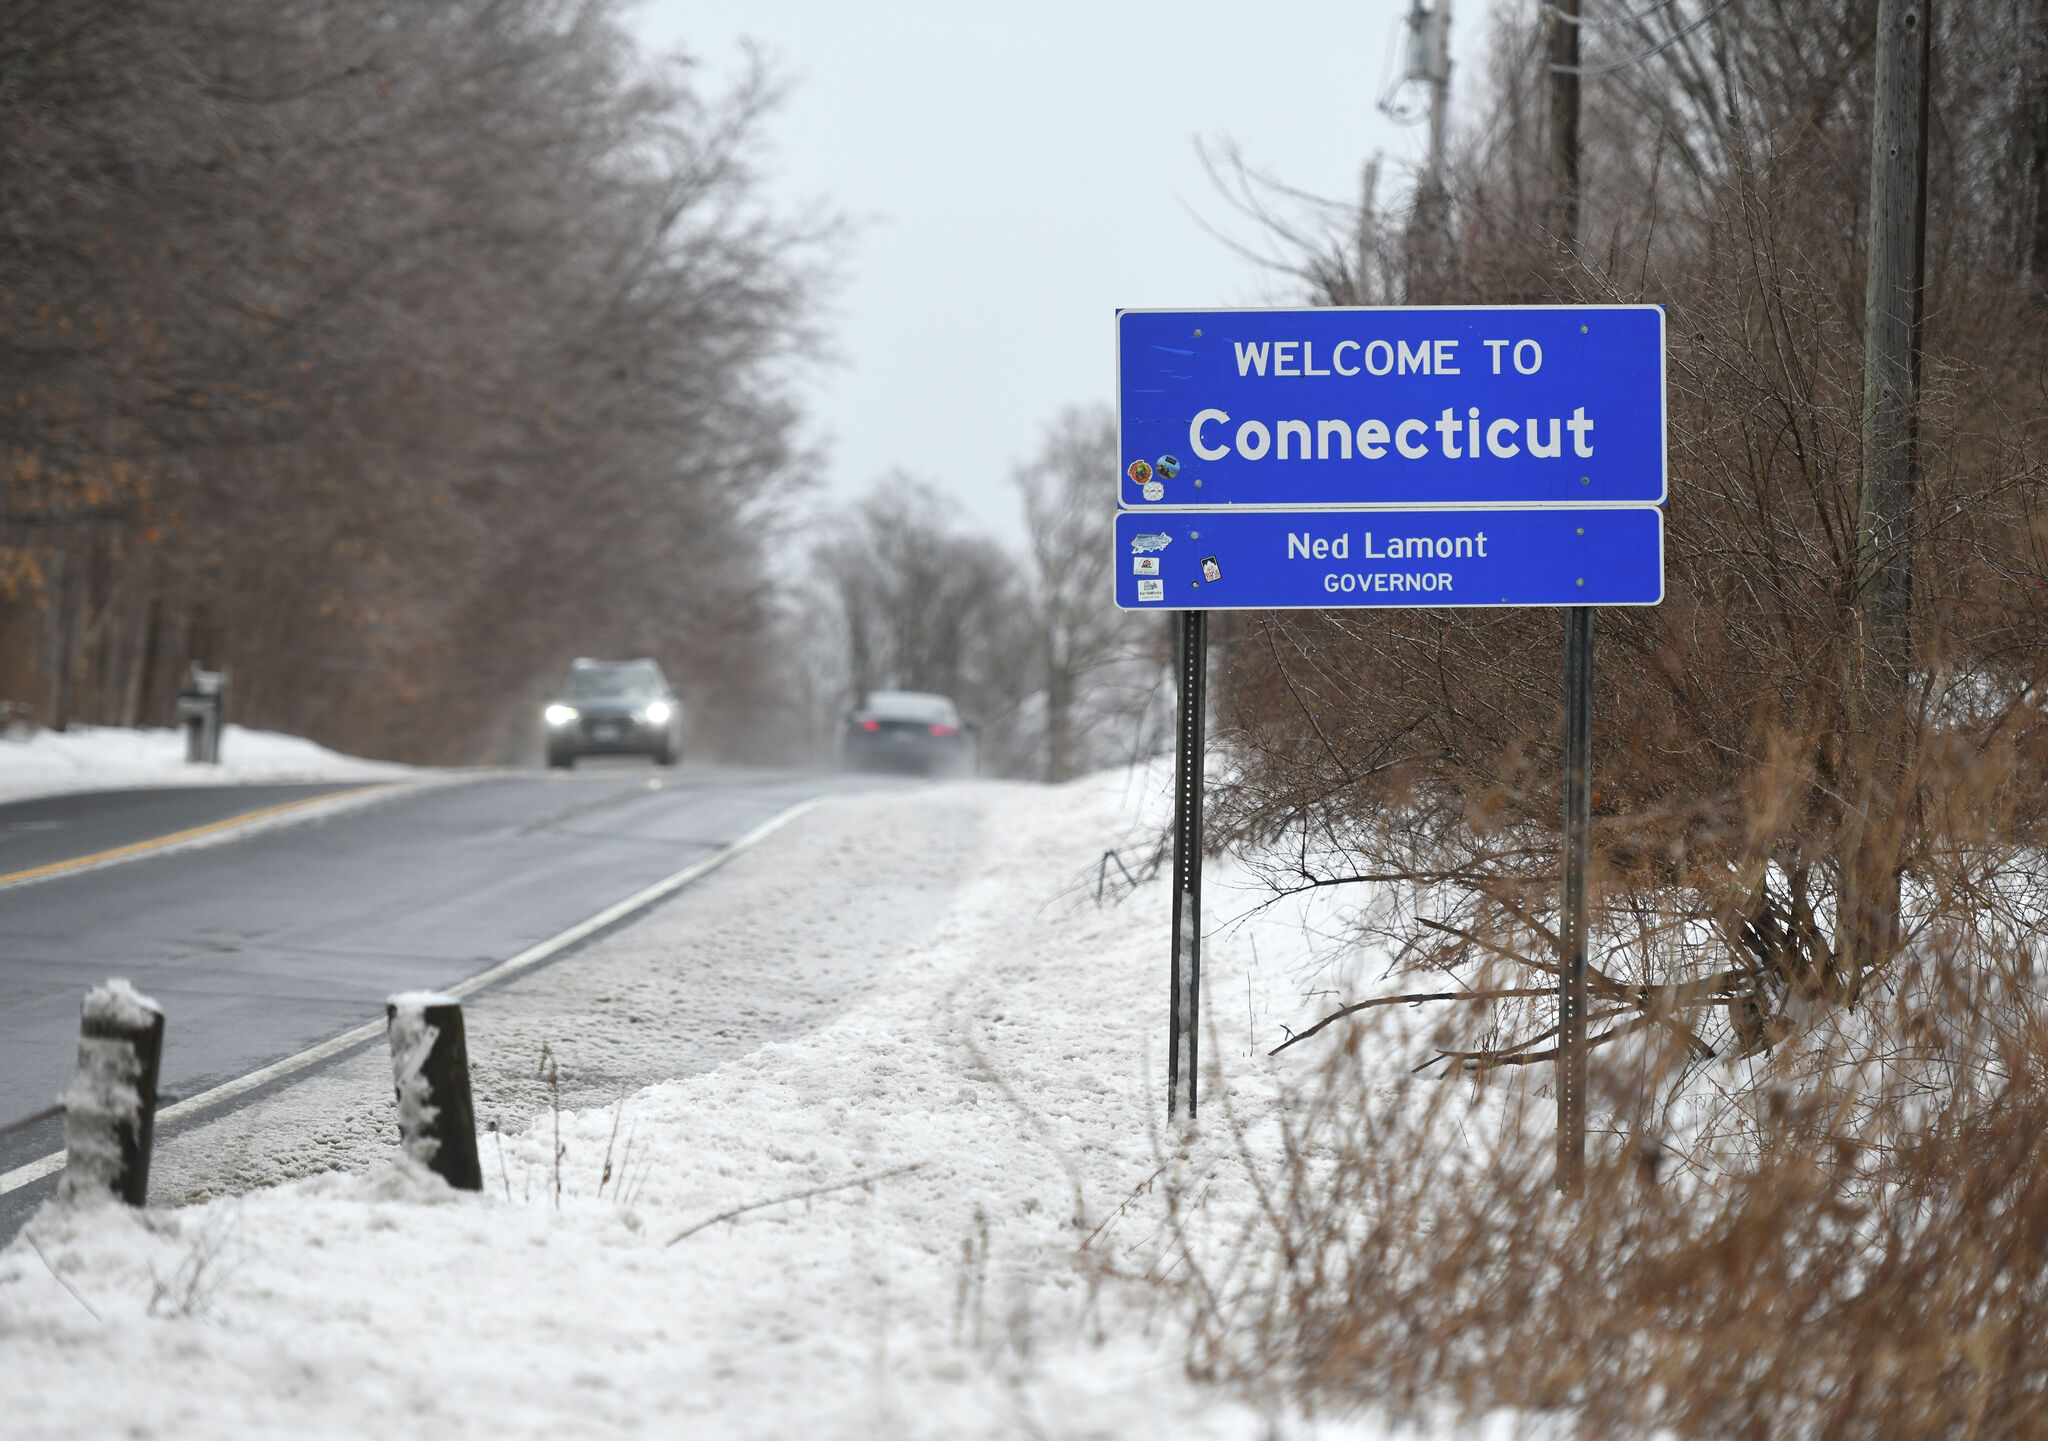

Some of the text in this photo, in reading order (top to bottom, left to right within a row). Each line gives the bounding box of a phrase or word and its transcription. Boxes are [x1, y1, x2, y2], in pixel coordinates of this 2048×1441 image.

[1233, 338, 1543, 377] WELCOME TO
[1189, 406, 1594, 461] Connecticut
[1288, 531, 1488, 560] Ned Lamont
[1324, 572, 1453, 593] GOVERNOR
